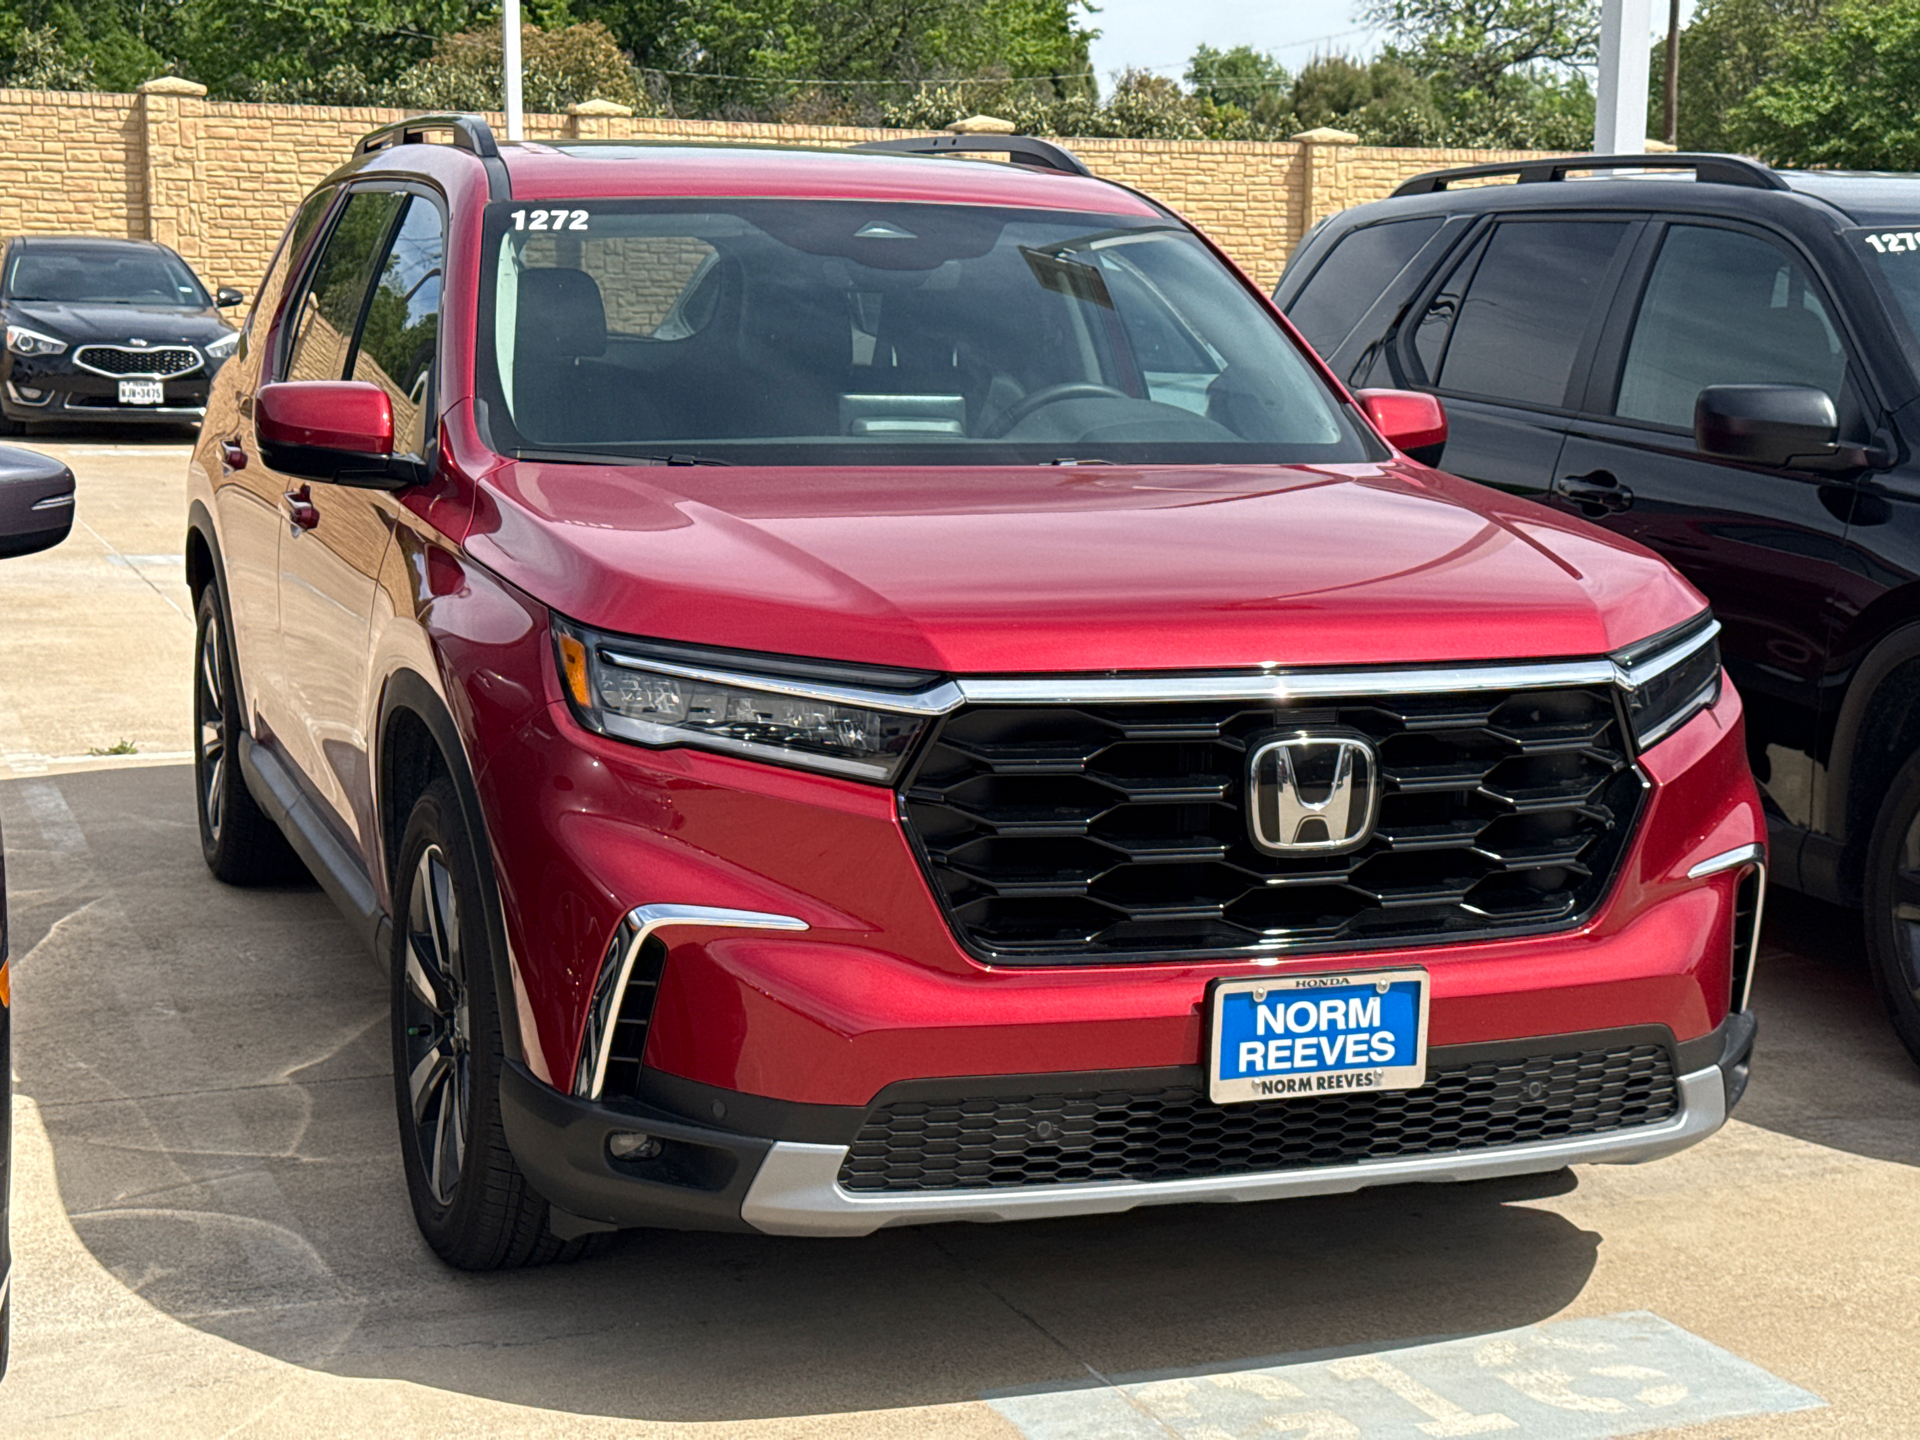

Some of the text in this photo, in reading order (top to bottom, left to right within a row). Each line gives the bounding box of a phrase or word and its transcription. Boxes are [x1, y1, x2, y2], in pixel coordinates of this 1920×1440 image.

[511, 209, 589, 230] 1272
[1295, 977, 1350, 988] HONDA
[1256, 997, 1381, 1035] NORM
[1238, 1031, 1396, 1073] REEVES
[1261, 1072, 1374, 1095] NORM REEVES
